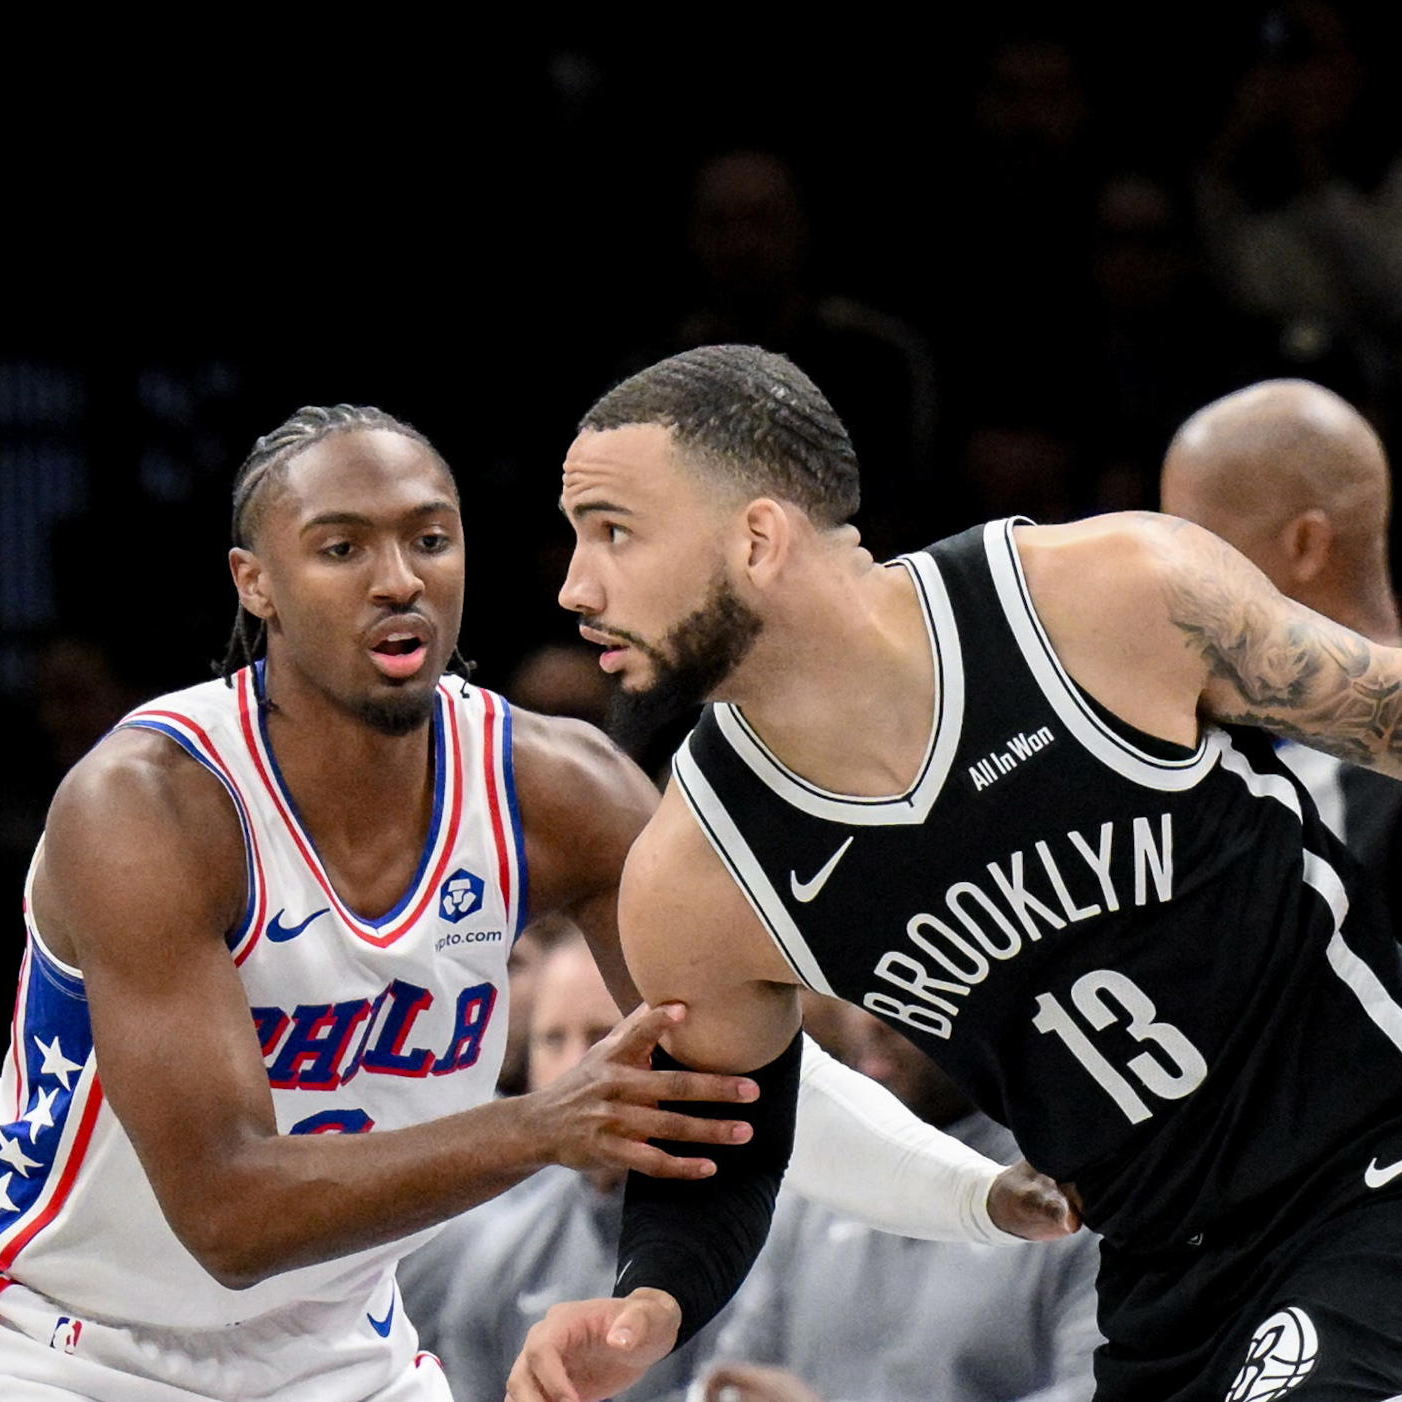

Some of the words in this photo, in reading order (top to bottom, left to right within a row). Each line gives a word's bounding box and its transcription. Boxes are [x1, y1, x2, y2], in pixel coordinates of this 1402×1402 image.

[968, 766, 999, 792] All
[989, 751, 1018, 775] In
[1006, 726, 1055, 762] Won
[435, 930, 502, 953] pto.com
[862, 812, 1174, 1041] BROOKLYN
[1031, 968, 1209, 1126] 13
